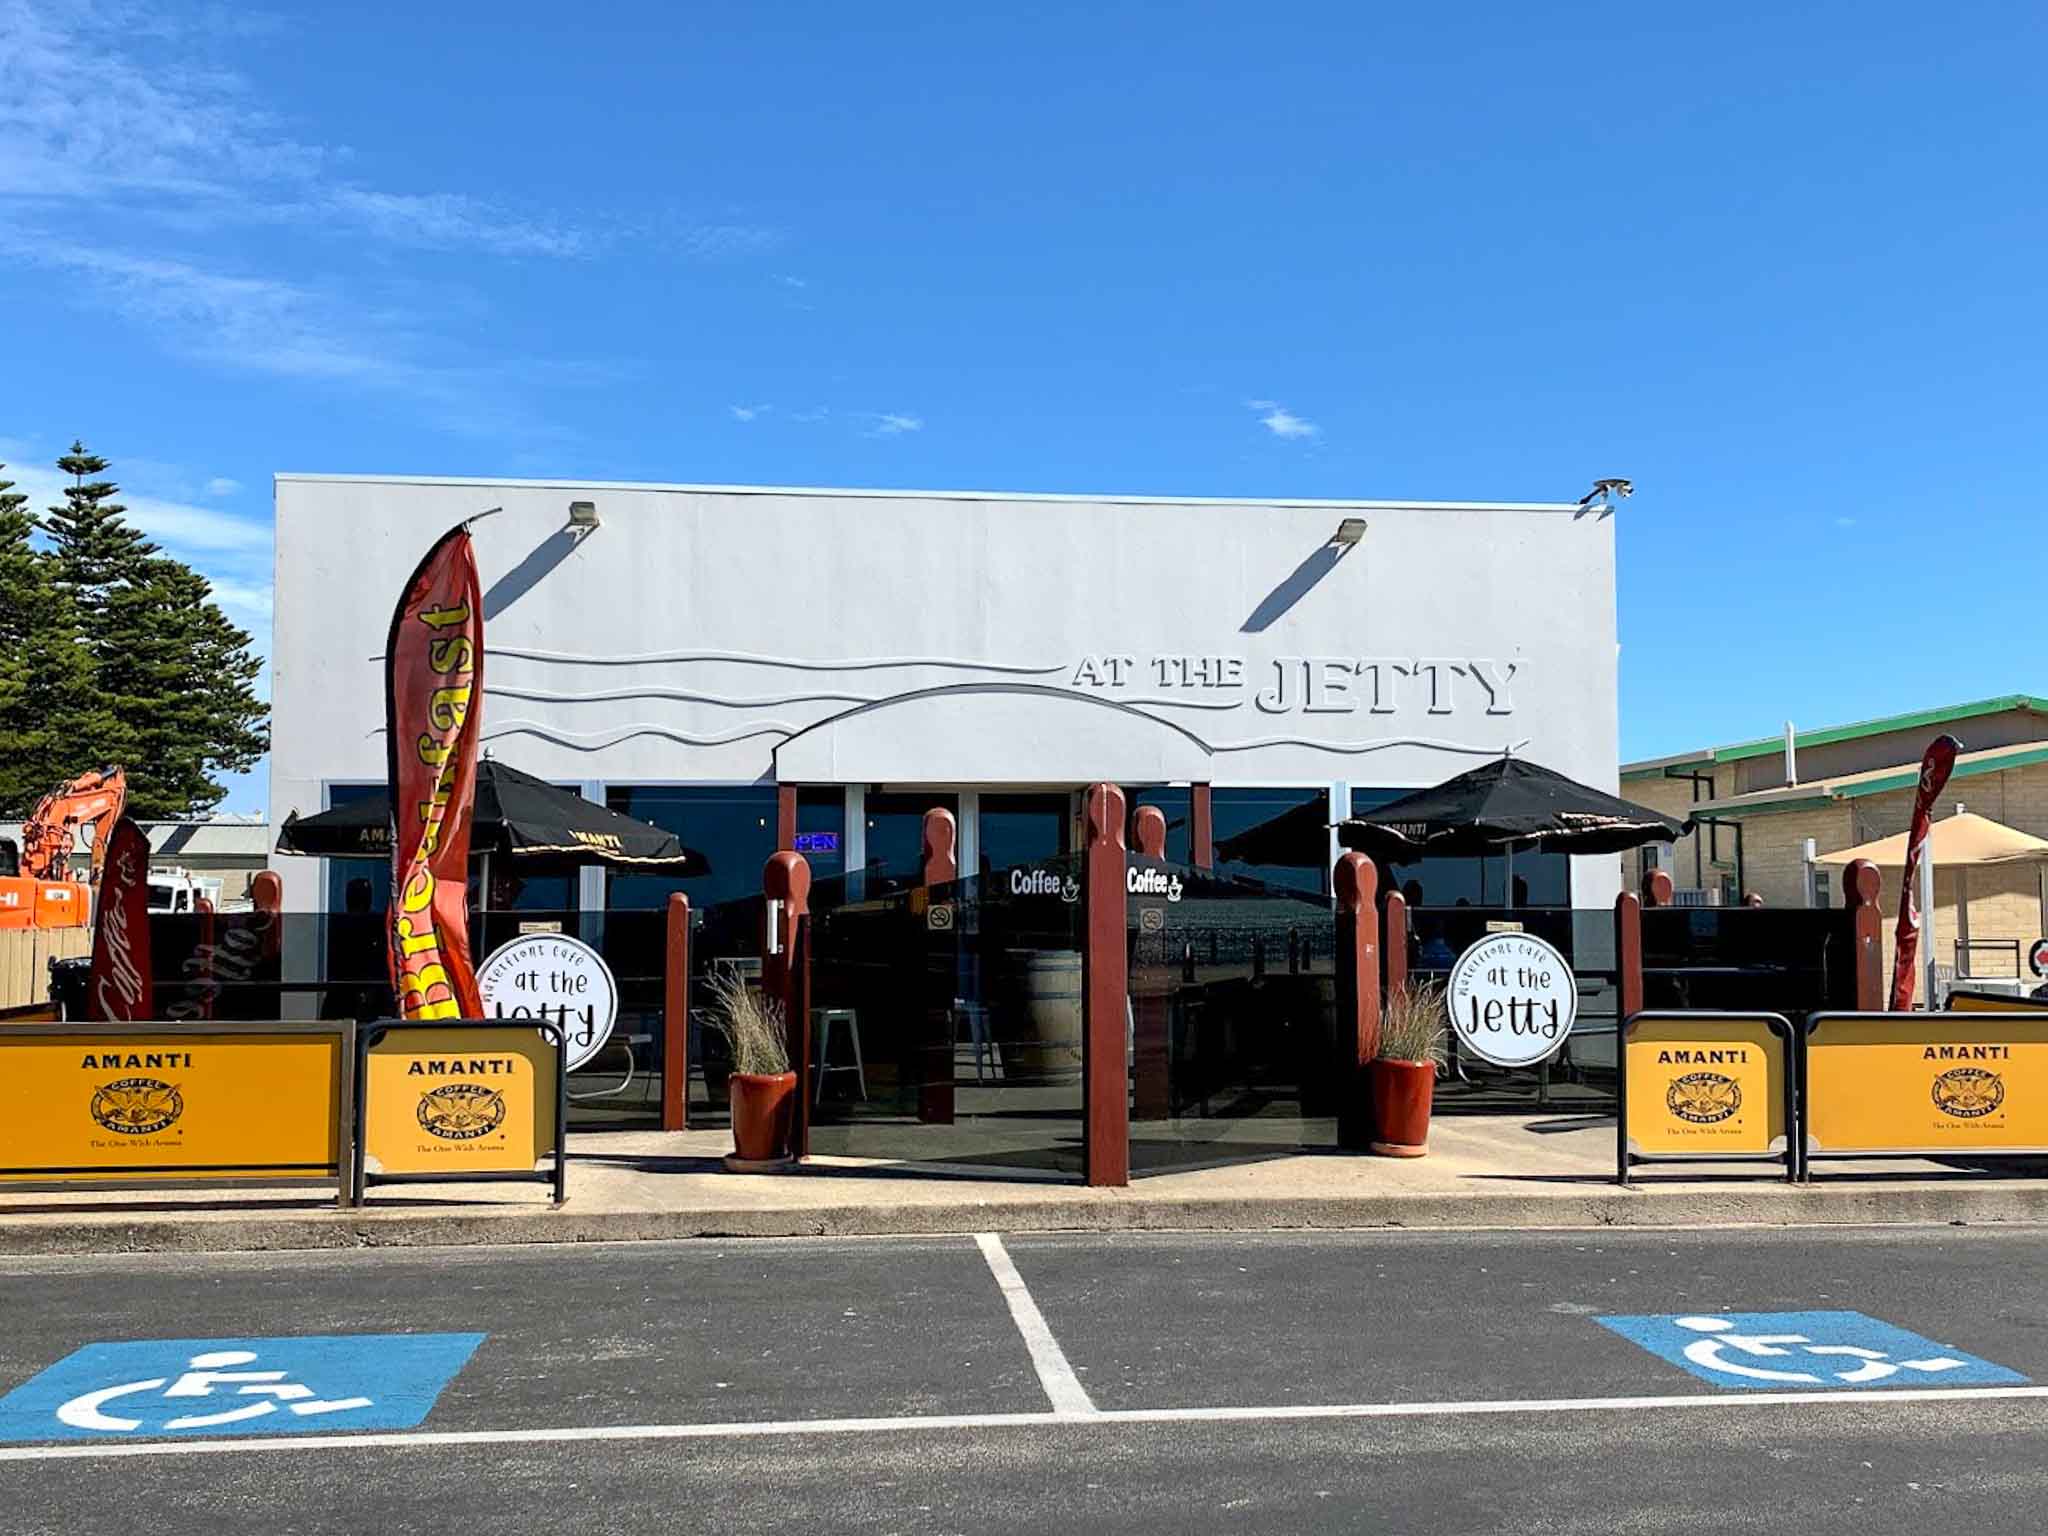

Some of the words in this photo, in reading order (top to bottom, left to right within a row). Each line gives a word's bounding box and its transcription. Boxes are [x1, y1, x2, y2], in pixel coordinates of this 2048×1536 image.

[1072, 656, 1136, 687] AT
[1151, 656, 1245, 688] THE
[1254, 655, 1531, 715] JETTY
[568, 829, 623, 849] MANTI
[794, 834, 838, 850] PEN
[1011, 869, 1061, 895] Coffee
[1127, 867, 1169, 893] Coffee
[514, 970, 540, 993] at
[550, 970, 588, 996] the
[1487, 966, 1508, 987] at
[1518, 967, 1551, 990] the
[81, 1053, 192, 1069] AMANTI
[1658, 1050, 1747, 1064] AMANTI
[1923, 1046, 2009, 1060] AMANTI
[407, 1059, 513, 1075] AMANTI
